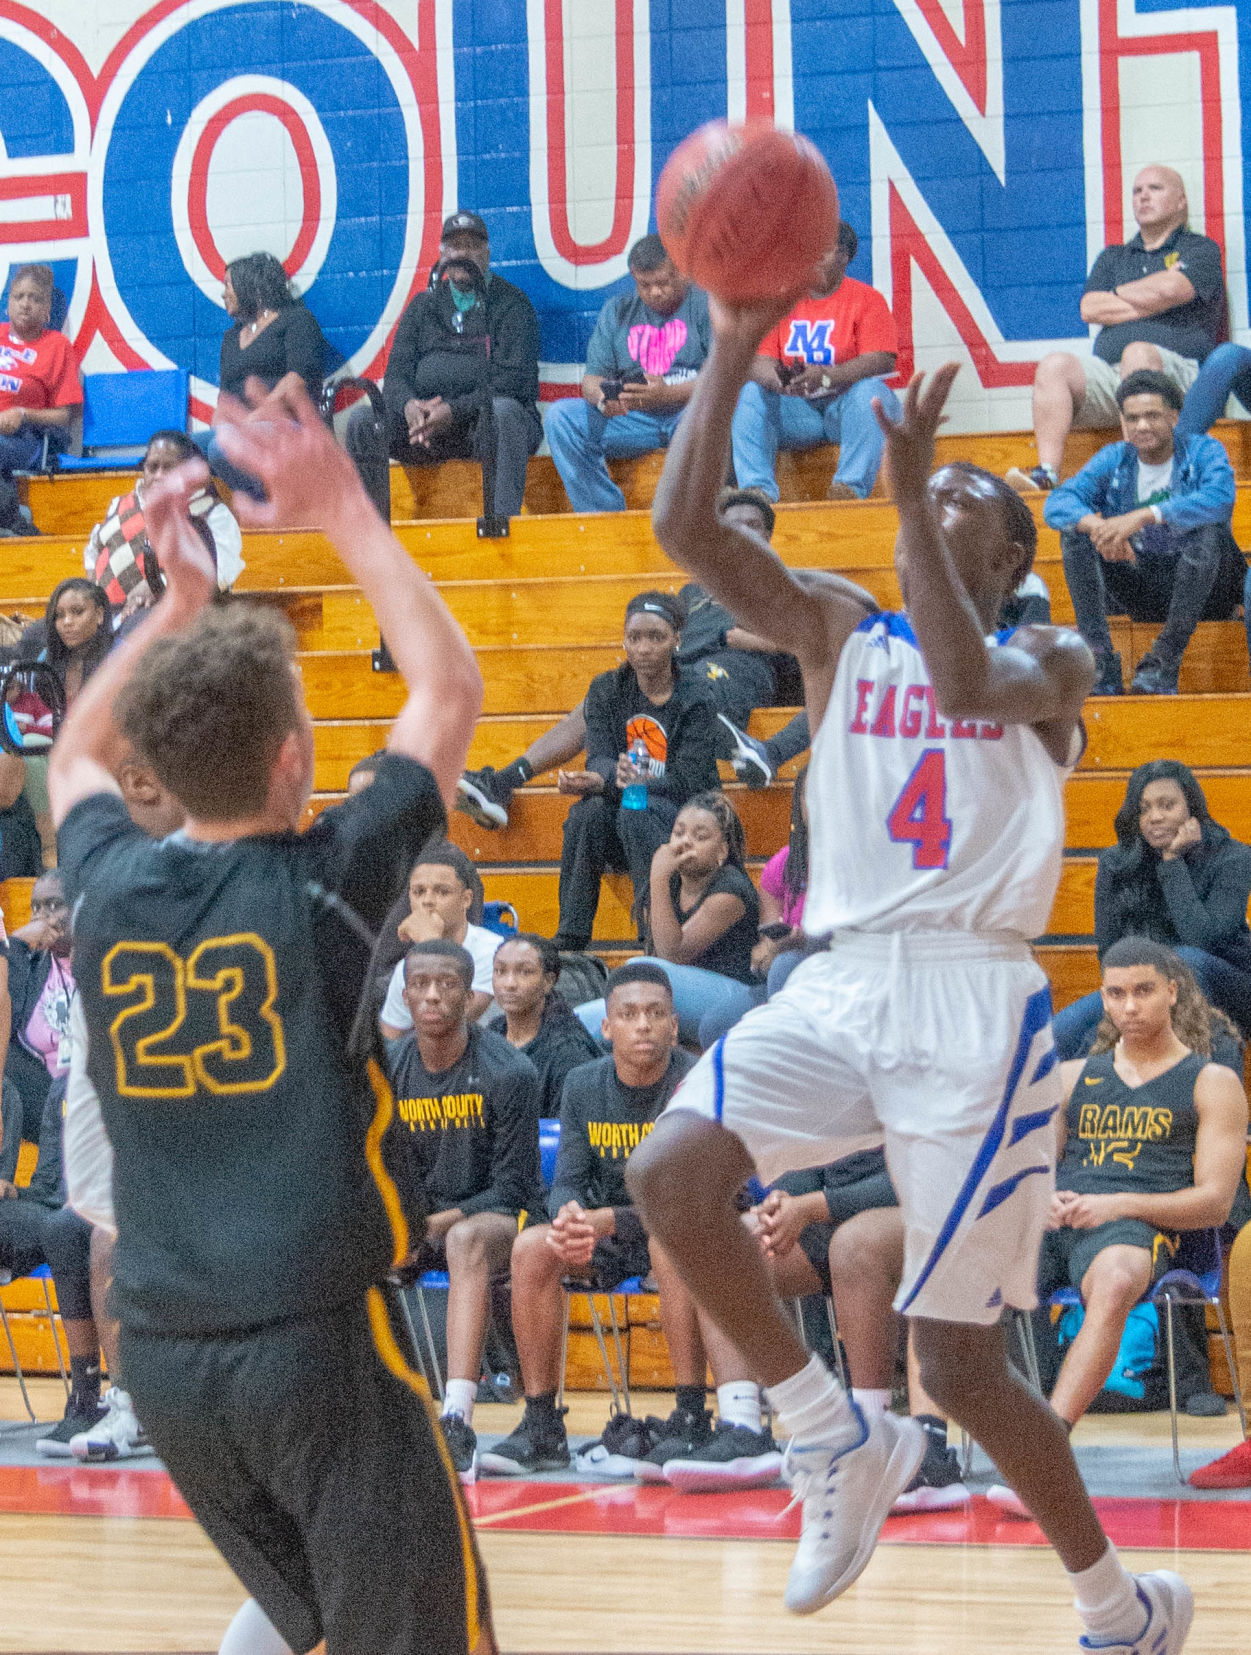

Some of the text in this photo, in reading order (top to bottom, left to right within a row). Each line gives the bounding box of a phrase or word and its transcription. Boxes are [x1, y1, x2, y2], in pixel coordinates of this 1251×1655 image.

[886, 747, 953, 870] 4
[101, 932, 287, 1099] 23
[587, 1121, 640, 1148] WORTH
[1078, 1104, 1173, 1140] RAMS
